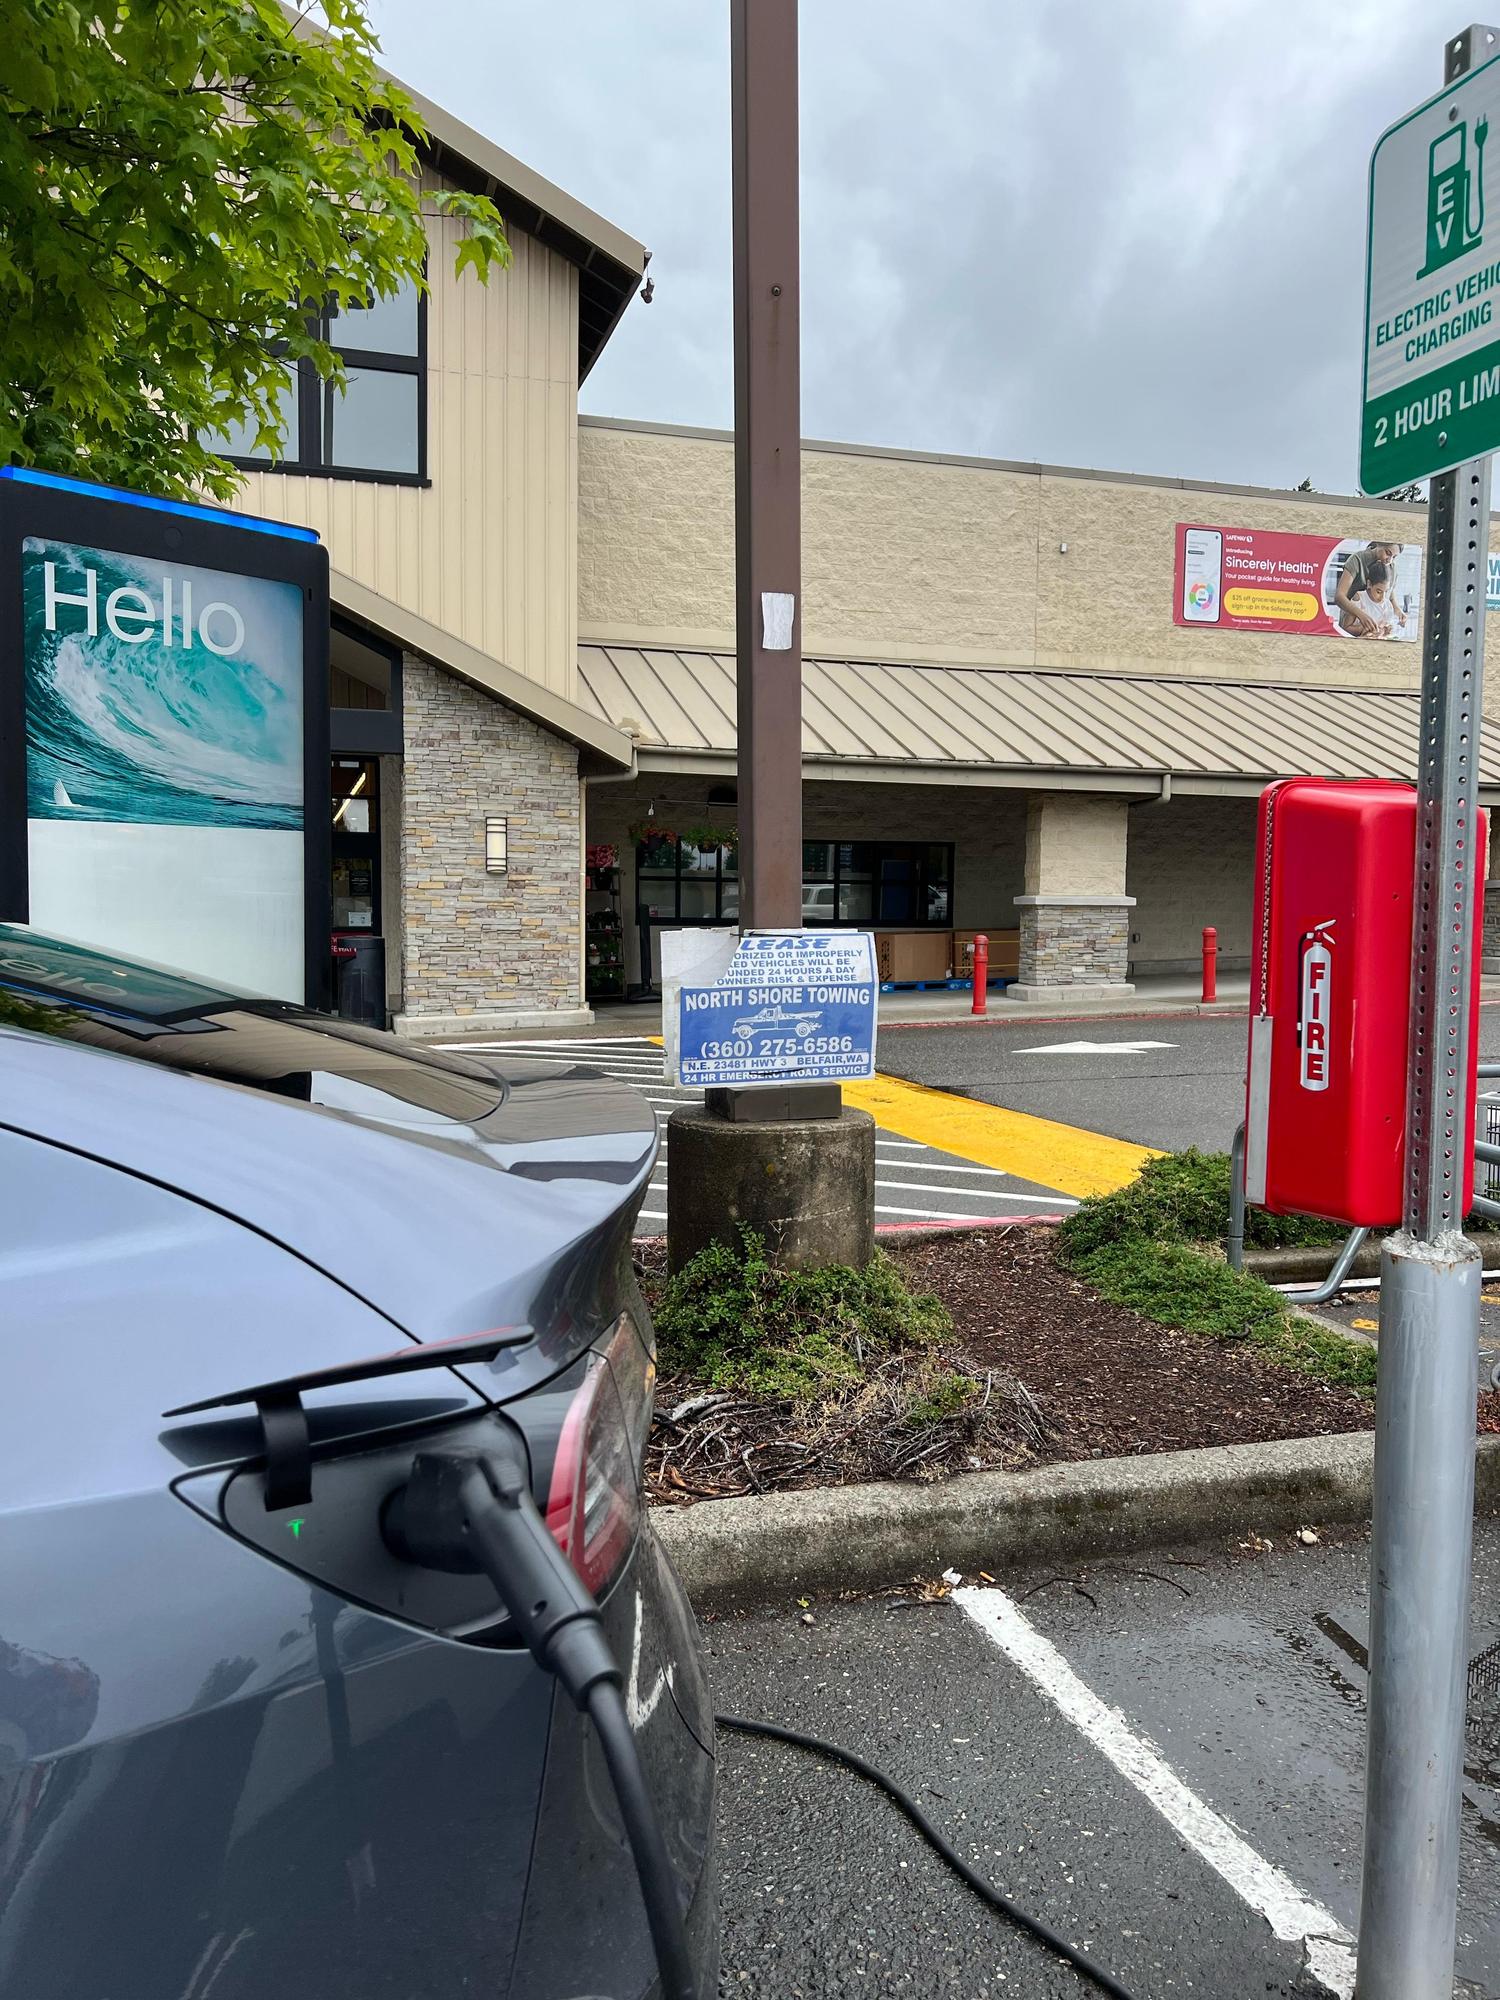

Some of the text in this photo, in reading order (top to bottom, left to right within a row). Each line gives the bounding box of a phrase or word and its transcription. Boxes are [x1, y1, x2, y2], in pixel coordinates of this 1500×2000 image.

[1376, 289, 1452, 347] ELECTRIC
[1405, 301, 1492, 362] CHARGING
[1374, 364, 1500, 448] 2 HOUR LIM
[1225, 548, 1253, 556] Introducing
[1225, 556, 1276, 574] Sincerely
[1237, 573, 1256, 581] pocket
[1281, 577, 1300, 586] healthy
[44, 560, 245, 656] Hello
[734, 950, 863, 960] ORIZED OR IMPROPERLY
[751, 959, 805, 968] VEHICLES
[716, 977, 764, 986] OWNERS
[797, 975, 804, 983] &
[808, 974, 857, 983] EXPENSE
[727, 969, 765, 977] UNDED
[784, 967, 822, 975] HOURS
[836, 966, 856, 974] DAY
[685, 987, 870, 1012] NORTH SHORE TOWING
[1306, 962, 1326, 1081] FIRE
[701, 1036, 853, 1059] (360) 275-6586
[688, 1062, 711, 1071] N.E.
[714, 1060, 747, 1070] 23481
[751, 1058, 777, 1068] HWY
[780, 1057, 787, 1067] 3
[684, 1074, 697, 1083] 24
[701, 1073, 717, 1082] HR
[790, 1068, 820, 1078] ROAD
[822, 1065, 868, 1076] SERVICE
